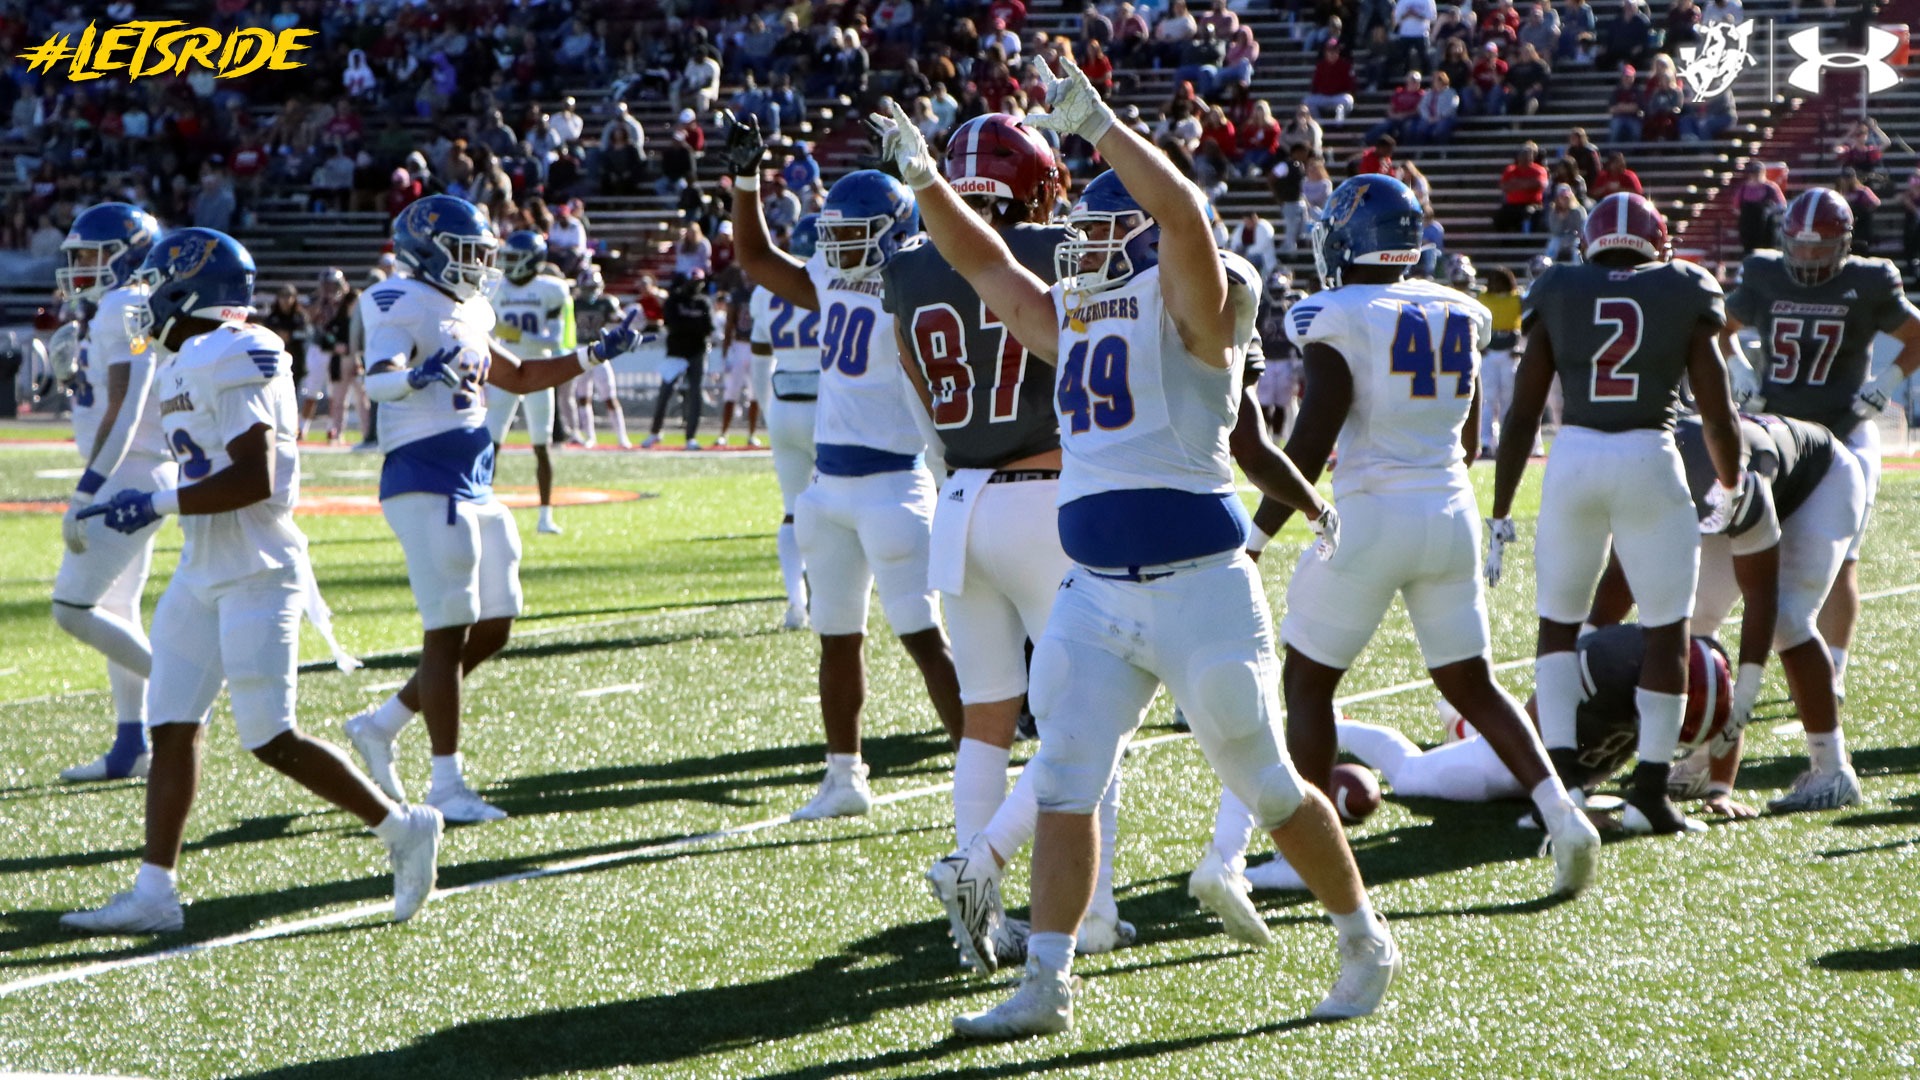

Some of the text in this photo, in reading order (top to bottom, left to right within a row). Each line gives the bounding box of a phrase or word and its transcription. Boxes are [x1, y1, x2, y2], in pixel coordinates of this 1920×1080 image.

[951, 180, 996, 193] Riddell
[1599, 235, 1644, 249] Riddell
[769, 294, 822, 348] 22
[820, 301, 876, 378] 90
[1390, 300, 1474, 399] 44
[1589, 296, 1644, 402] 2
[1770, 317, 1846, 386] 57
[911, 299, 1029, 431] 87
[1054, 334, 1136, 436] 49
